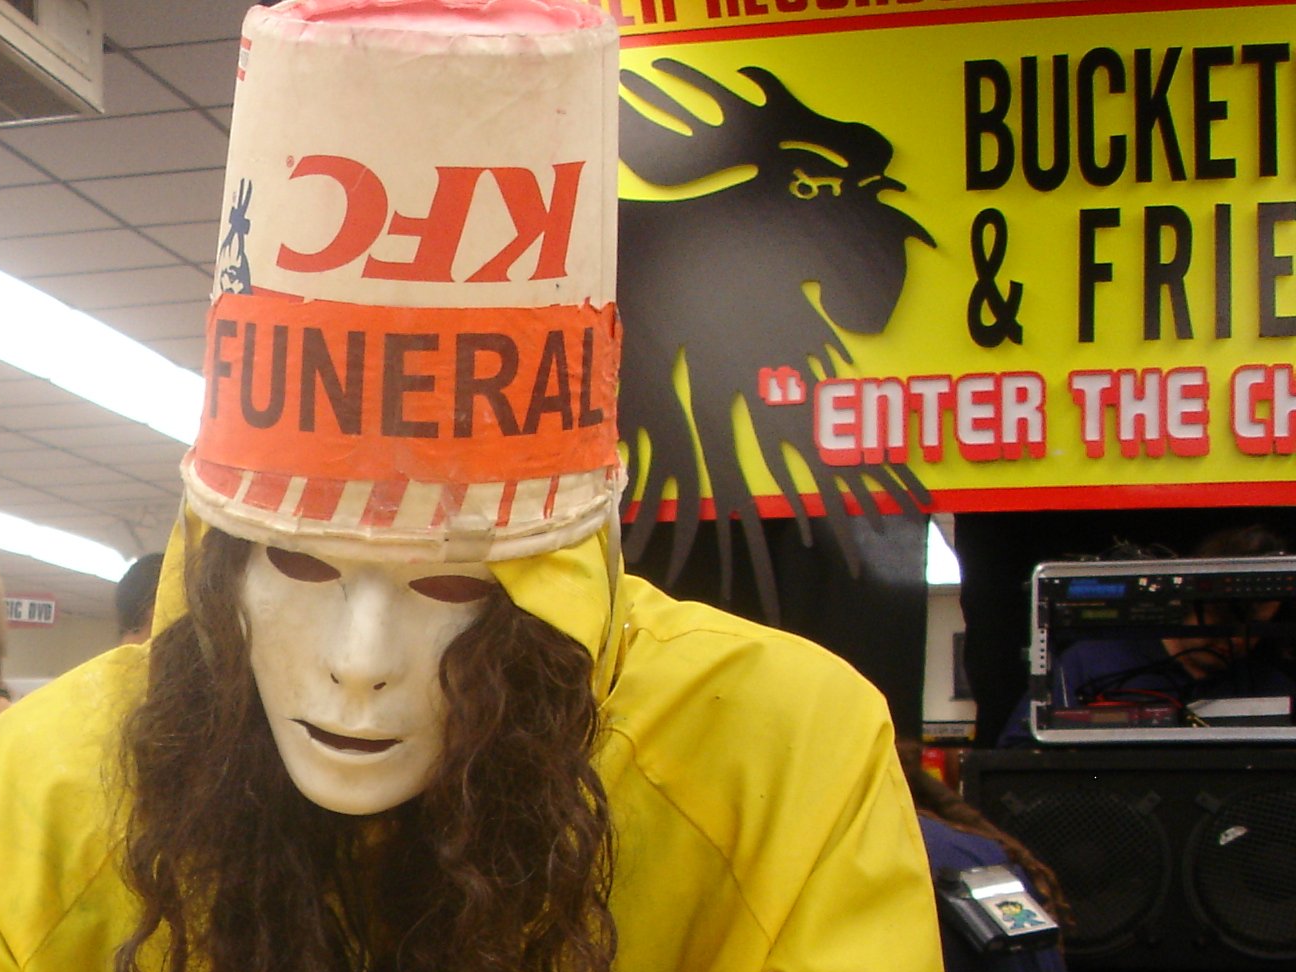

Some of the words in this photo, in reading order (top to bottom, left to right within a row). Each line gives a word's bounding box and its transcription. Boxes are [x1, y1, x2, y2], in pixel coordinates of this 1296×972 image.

[276, 155, 586, 283] KFC
[967, 208, 1024, 348] &
[1078, 201, 1296, 344] FRIE
[209, 318, 603, 439] FUNERAL
[1070, 366, 1209, 460] THE
